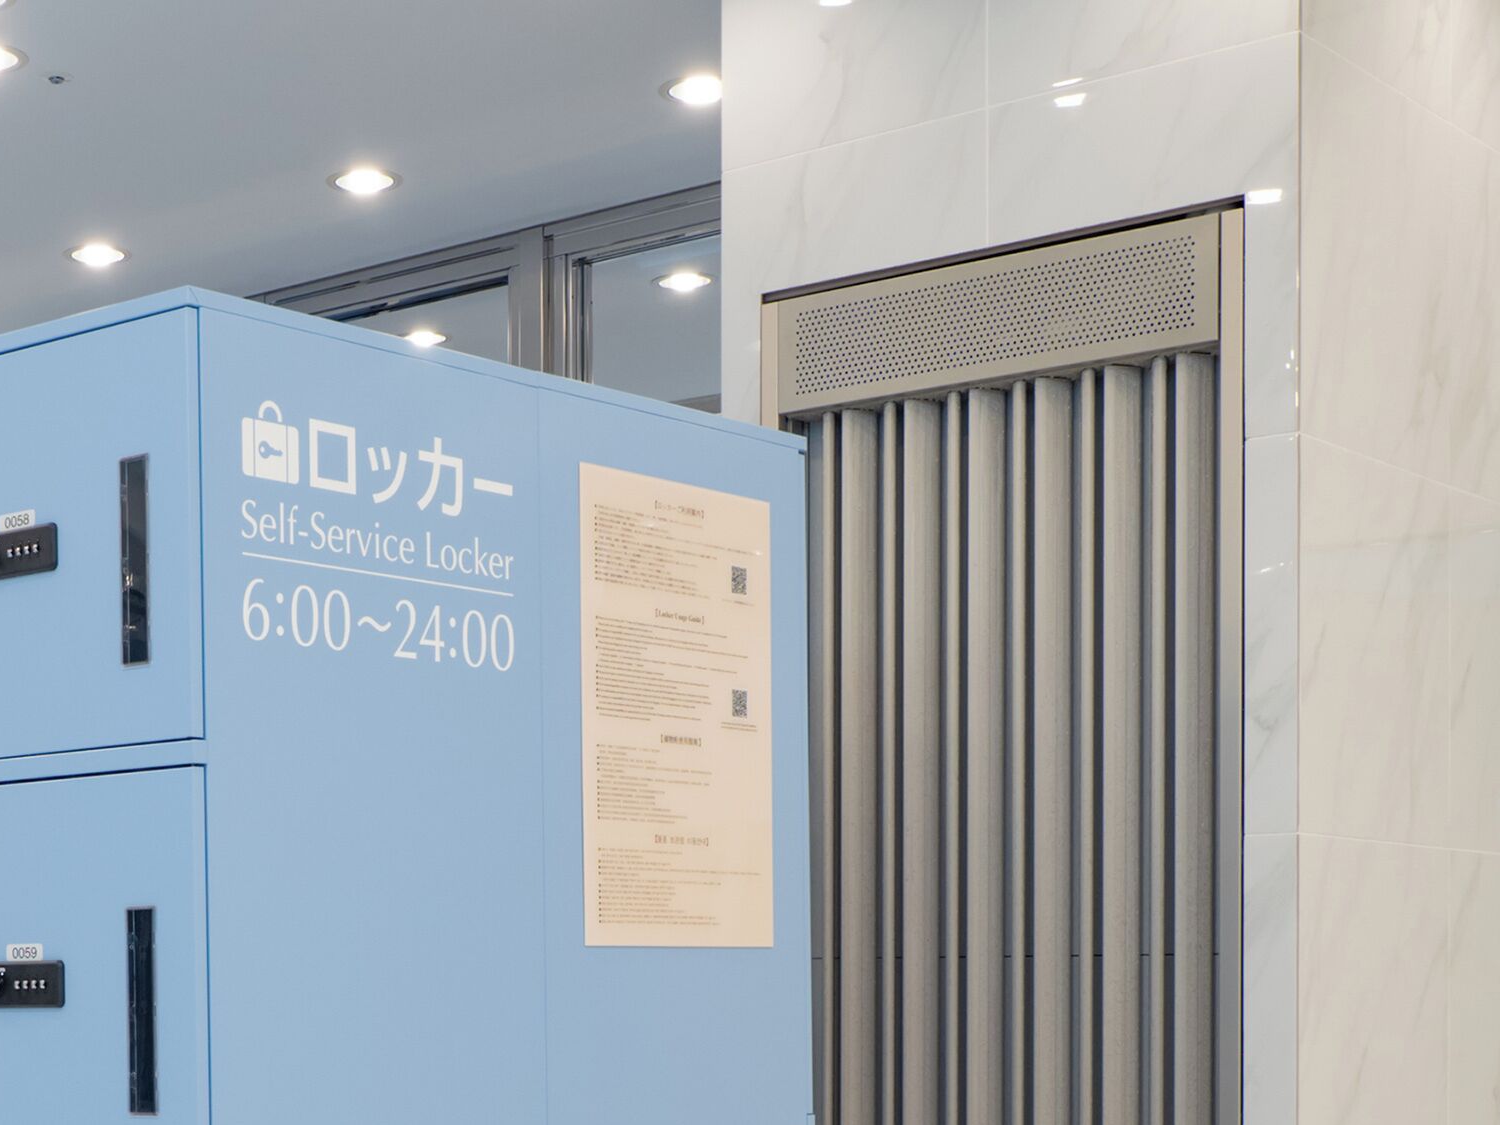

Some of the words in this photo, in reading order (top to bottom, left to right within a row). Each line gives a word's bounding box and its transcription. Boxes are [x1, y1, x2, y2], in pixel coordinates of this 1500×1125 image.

[309, 417, 513, 517] ロッカー
[4, 513, 30, 529] 0058
[241, 499, 415, 564] Self-Service
[426, 531, 514, 580] Locker
[12, 946, 37, 959] 0059
